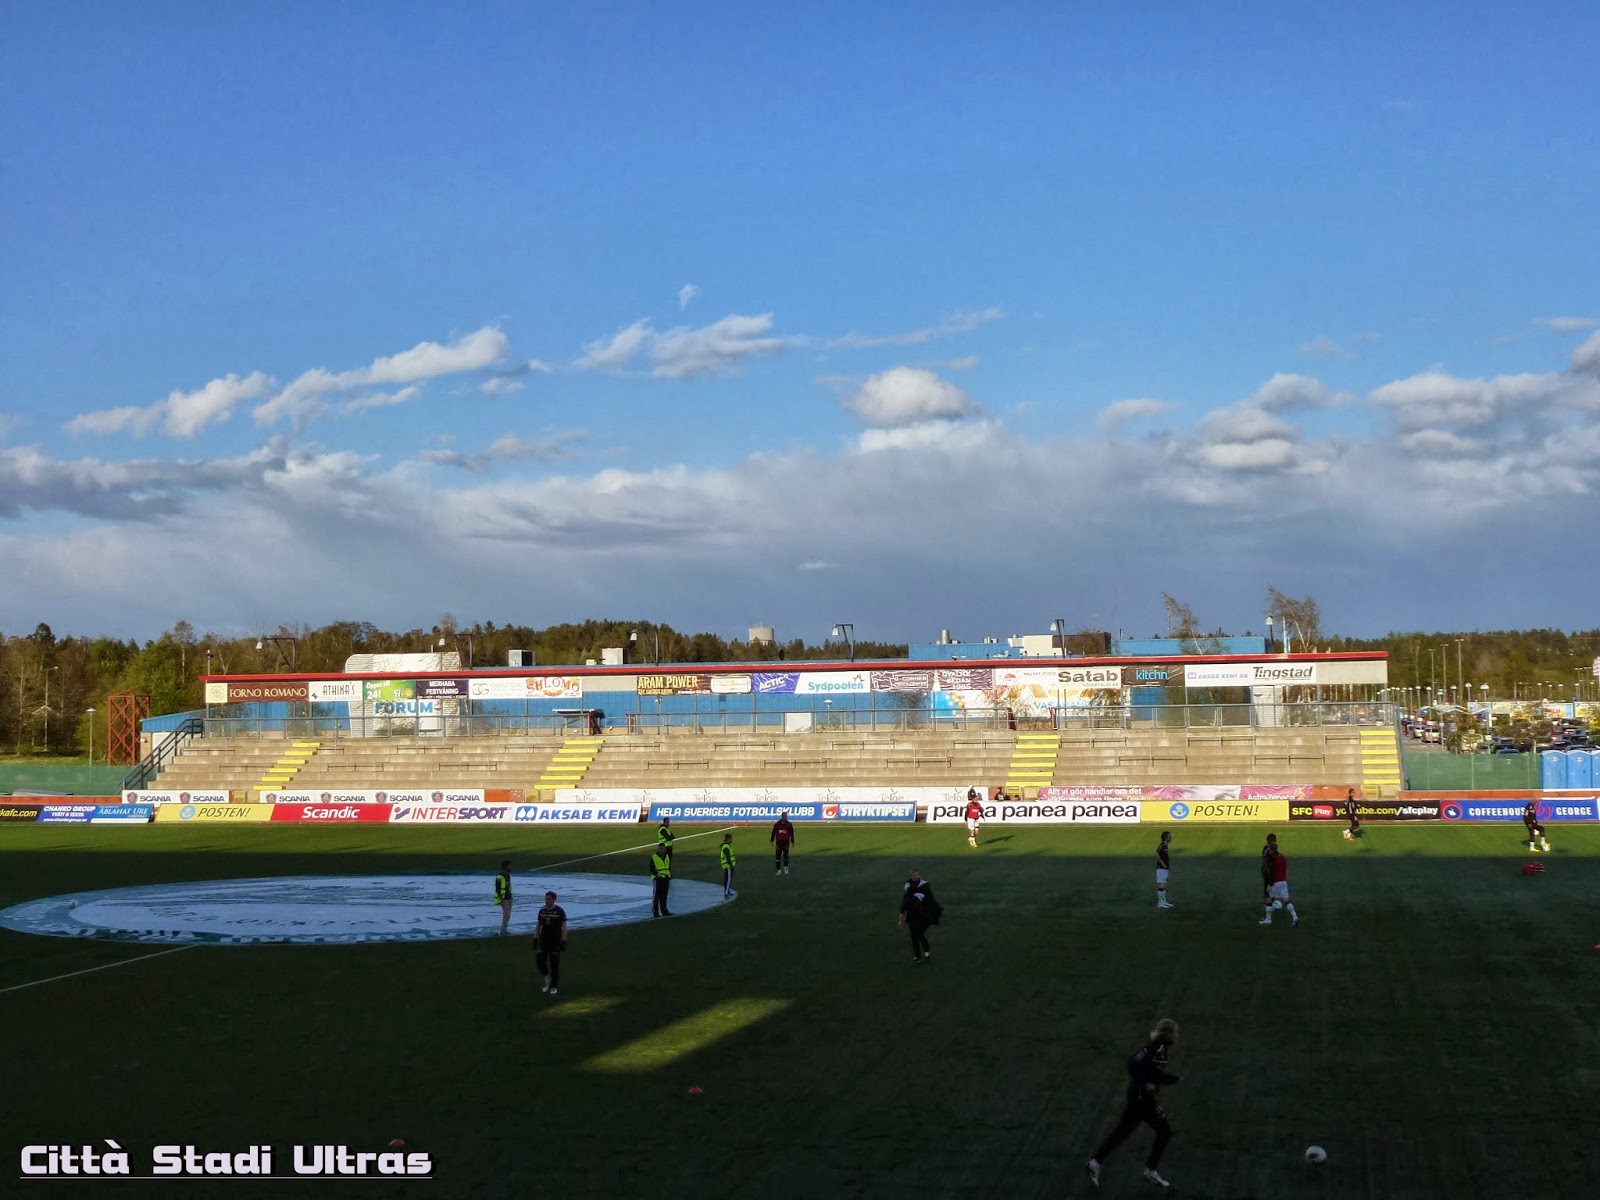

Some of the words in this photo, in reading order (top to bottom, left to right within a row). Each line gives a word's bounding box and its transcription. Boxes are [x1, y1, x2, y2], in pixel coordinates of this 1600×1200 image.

[1058, 670, 1118, 683] Satab
[1136, 670, 1169, 680] kitchn
[1253, 666, 1313, 680] Tingstad
[526, 677, 580, 694] SHLOMO
[638, 677, 664, 689] ARAM
[666, 676, 698, 688] POWER
[760, 677, 785, 691] ACTIC
[808, 681, 864, 692] Sydpoolen
[230, 688, 261, 698] FORNO
[264, 688, 307, 697] ROMANO
[367, 690, 382, 700] 24!
[375, 702, 433, 714] FORUM
[1070, 788, 1083, 797] gör
[198, 807, 251, 818] POSTEN!
[302, 806, 361, 819] Scandic
[412, 807, 508, 820] INTERSPORT
[539, 810, 592, 820] AKSAB
[597, 810, 638, 820] KEMI
[656, 808, 682, 817] HELA
[684, 807, 731, 817] SVERIGES
[733, 807, 815, 817] FOTBOLLSKLUBB
[841, 806, 911, 817] STRYKTIPSET
[1002, 805, 1067, 821] panea
[1072, 804, 1138, 821] panea
[1194, 805, 1260, 817] POSTEN!
[1292, 807, 1313, 816] SFC
[1315, 808, 1331, 817] Play
[1536, 800, 1554, 821] by
[1556, 807, 1592, 816] GEORGE
